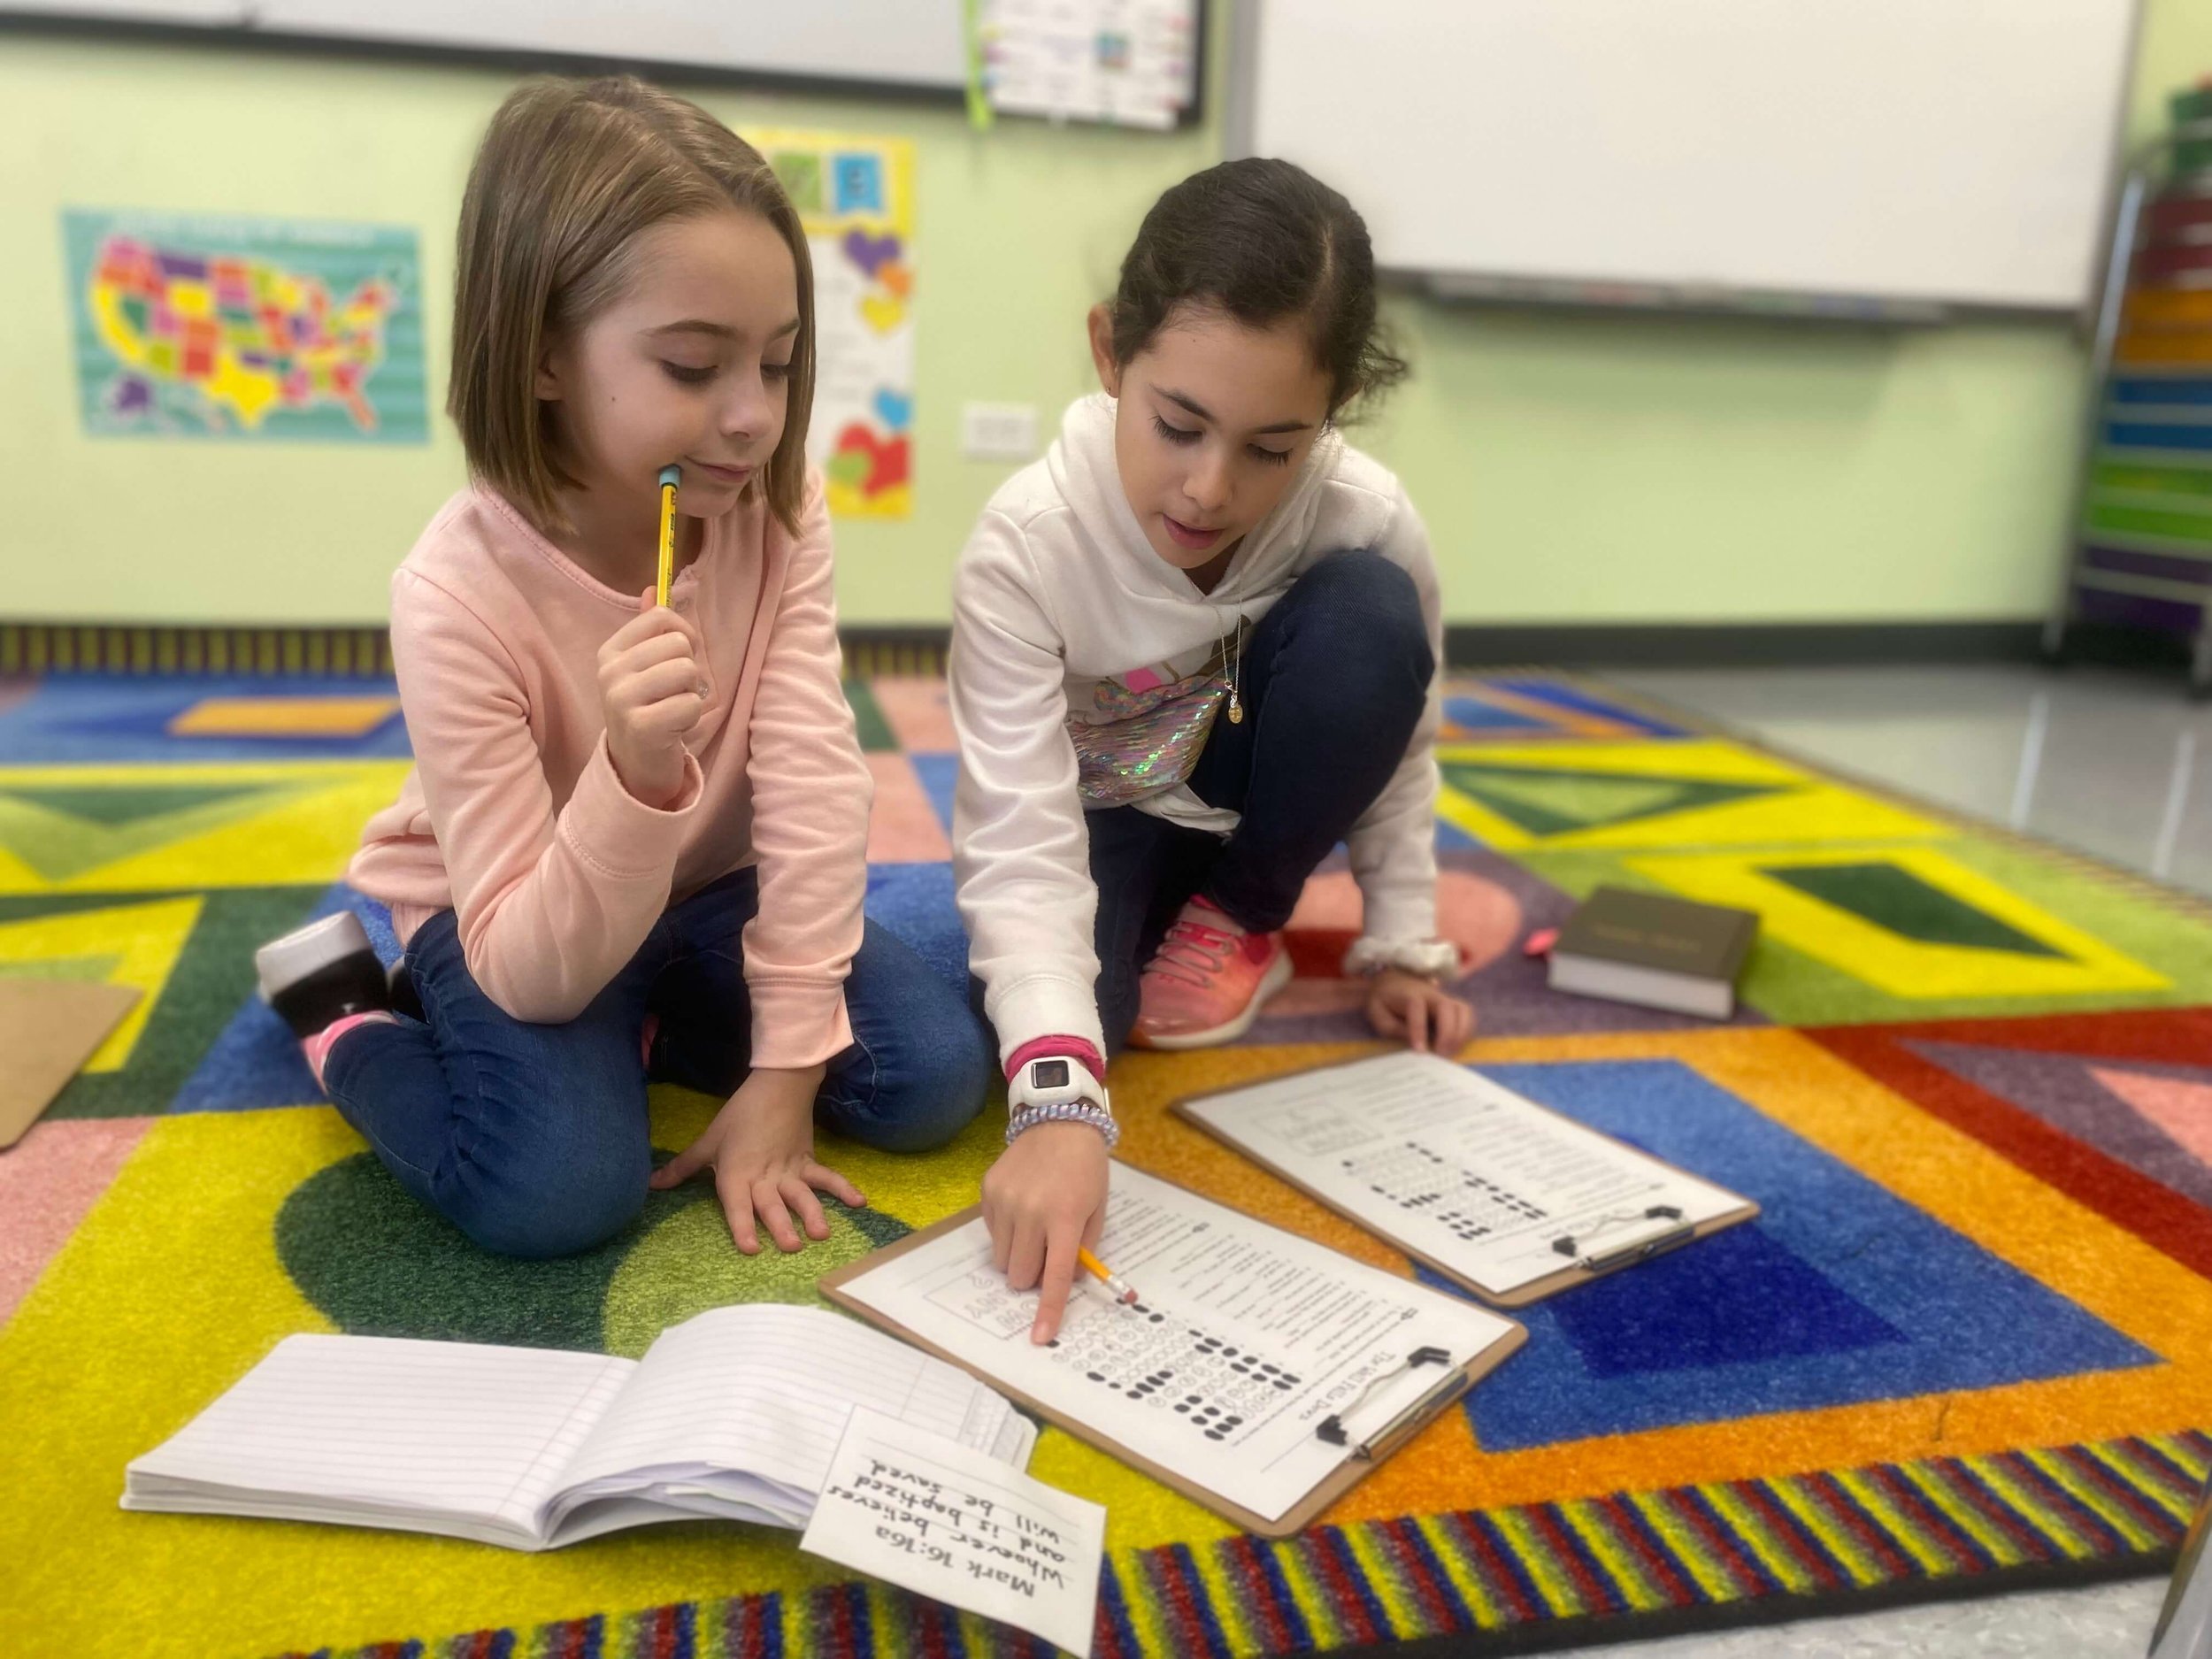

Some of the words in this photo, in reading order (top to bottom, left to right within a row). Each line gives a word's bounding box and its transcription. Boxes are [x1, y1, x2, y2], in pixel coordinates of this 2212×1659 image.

[872, 1460, 942, 1494] saved
[827, 1485, 929, 1537] believes
[854, 1476, 962, 1526] baptized
[964, 1494, 995, 1517] be
[876, 1525, 954, 1568] 16:16a
[979, 1520, 998, 1538] is
[949, 1533, 1064, 1589] Whoever
[1019, 1537, 1065, 1563] and
[968, 1559, 1035, 1597] Mark
